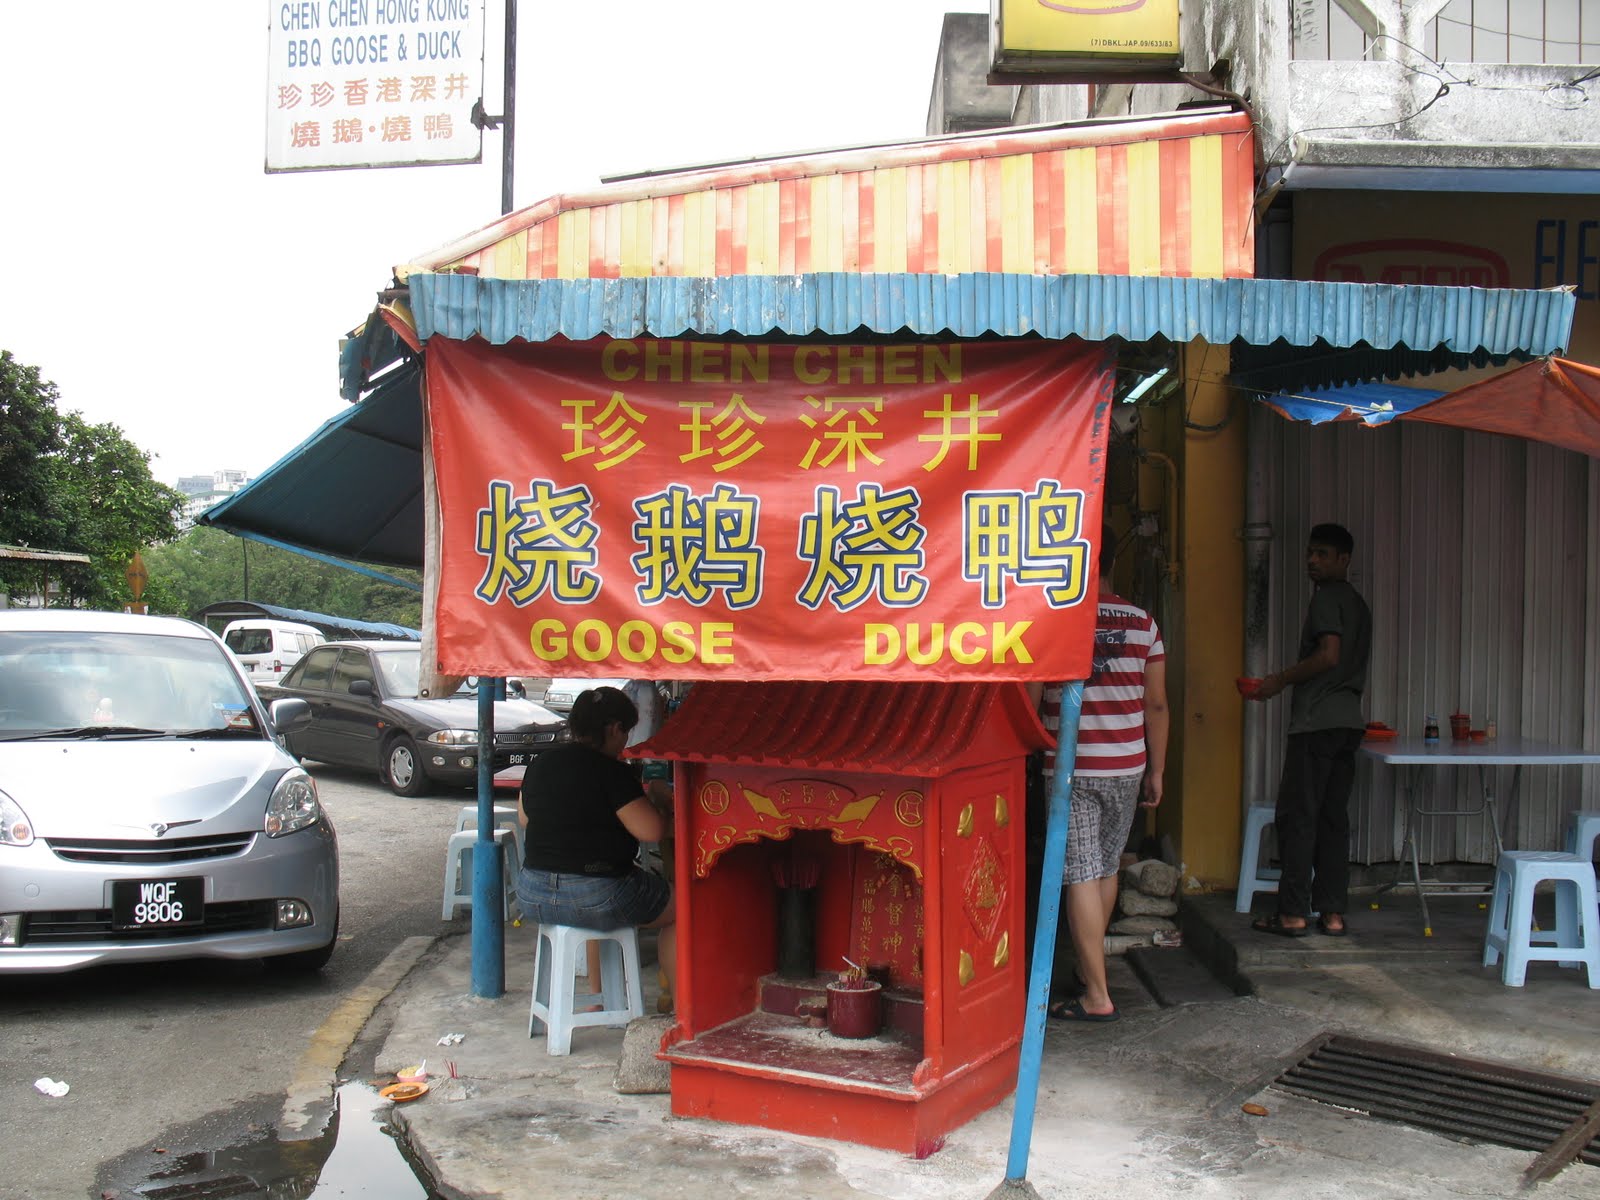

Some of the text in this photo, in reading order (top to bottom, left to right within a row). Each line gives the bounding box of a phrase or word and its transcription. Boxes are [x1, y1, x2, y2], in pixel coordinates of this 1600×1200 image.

[281, 0, 469, 31] CHEN CHEN HONG KONG
[288, 30, 462, 67] BBQ GOOSE & DUCK
[278, 73, 470, 110] 珍珍香港深井
[601, 340, 963, 385] CHEN CHEN
[560, 391, 1003, 474] 珍珍深井
[530, 618, 1035, 667] GOOSE DUCK
[140, 882, 177, 903] WQF
[135, 902, 183, 923] 9806
